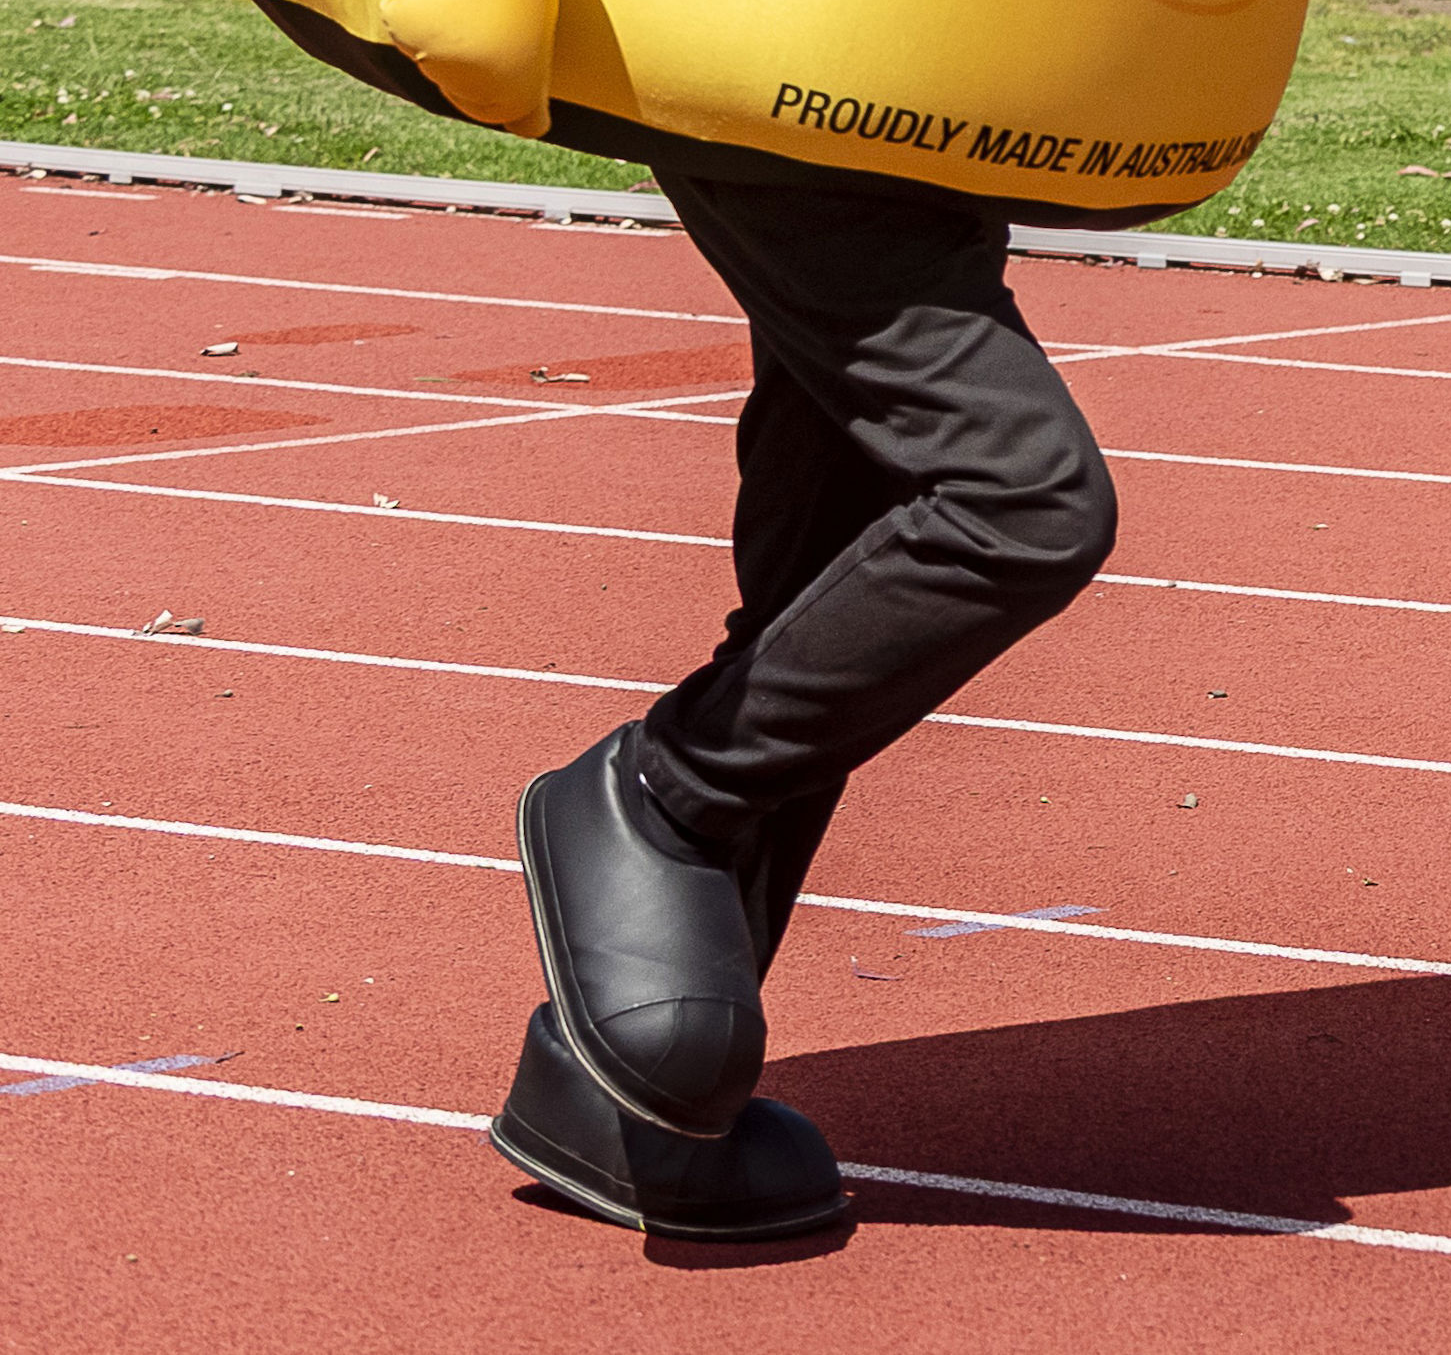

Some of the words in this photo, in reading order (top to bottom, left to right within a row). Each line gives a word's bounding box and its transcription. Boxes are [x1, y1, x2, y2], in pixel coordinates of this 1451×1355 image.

[771, 82, 968, 153] PROUDLY
[967, 124, 1083, 173] MADE
[1077, 140, 1124, 177] IN
